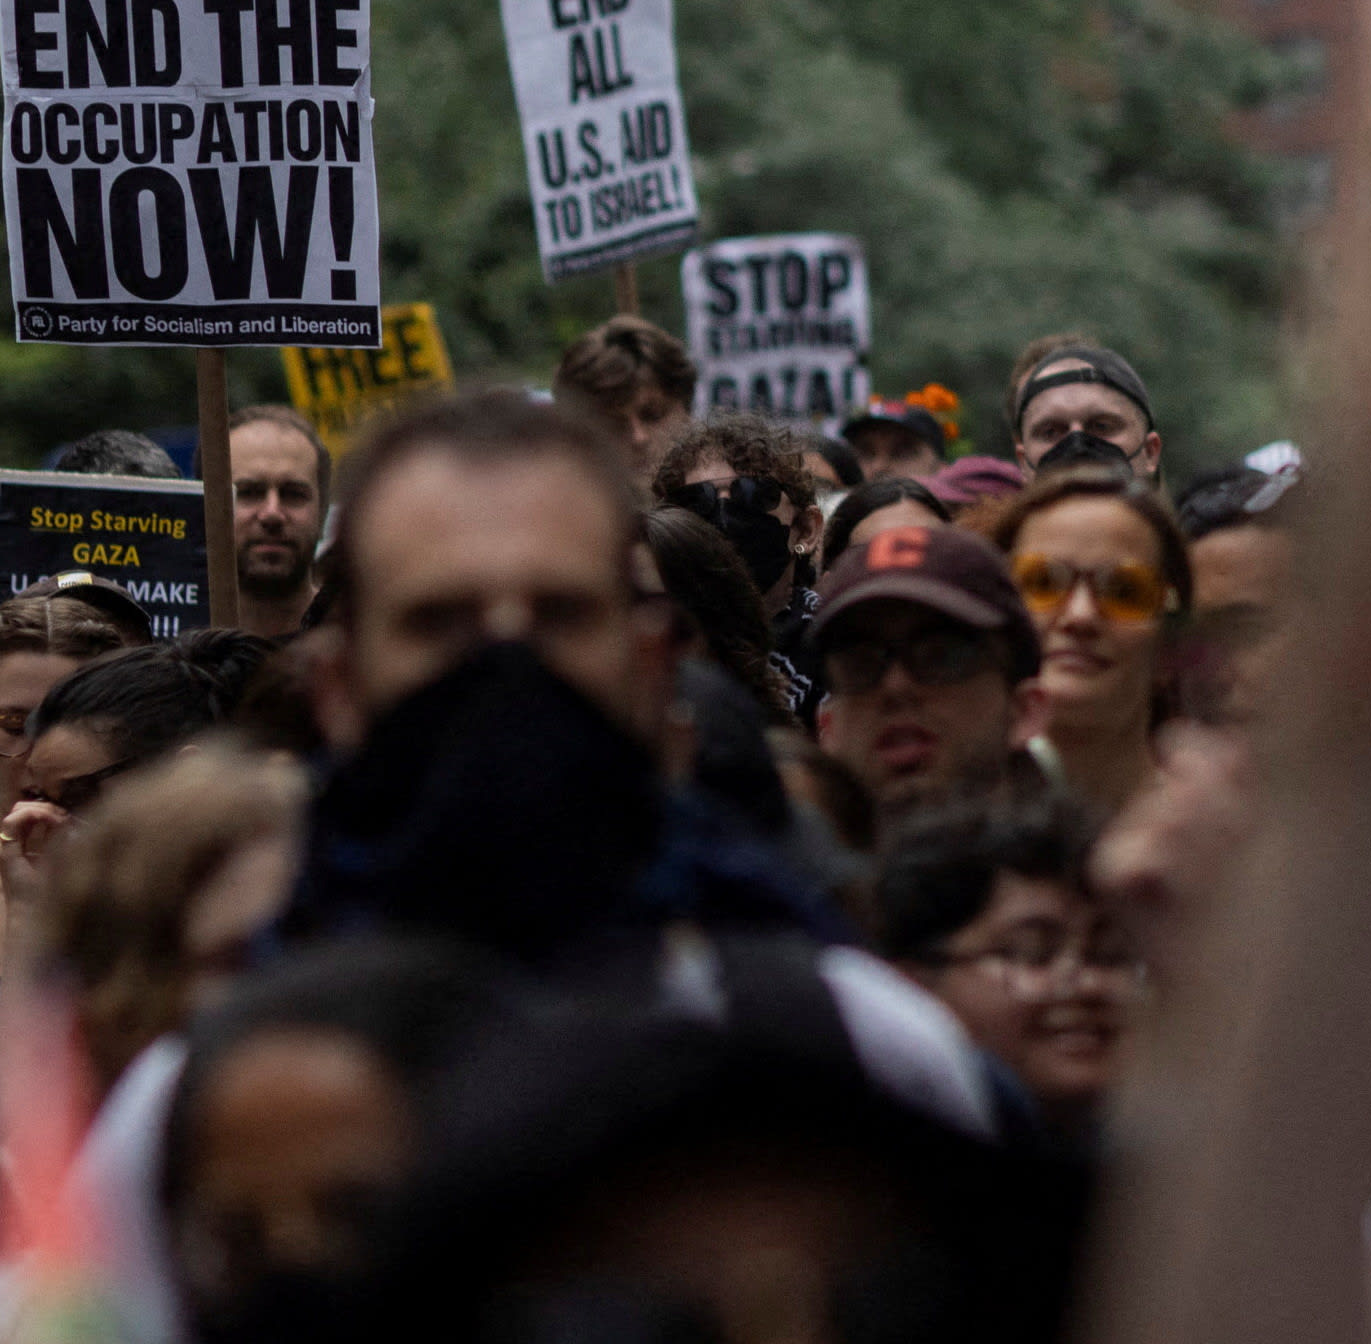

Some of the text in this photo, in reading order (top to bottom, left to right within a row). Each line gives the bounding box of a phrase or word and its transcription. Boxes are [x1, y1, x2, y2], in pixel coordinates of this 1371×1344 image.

[569, 22, 633, 104] ALL
[10, 98, 361, 165] OCCUPATION
[537, 102, 673, 189] U.S. AID
[16, 165, 357, 301] NOW!
[545, 164, 684, 243] TO ISRAEL!
[705, 250, 850, 317] STOP
[58, 314, 106, 335] Party
[112, 314, 139, 332] for
[144, 315, 233, 336] Socialism
[239, 317, 276, 334] and
[281, 316, 372, 336] Liberation
[31, 506, 187, 539] Stop Starving
[72, 542, 141, 567] GAZA
[127, 580, 200, 605] MAKE
